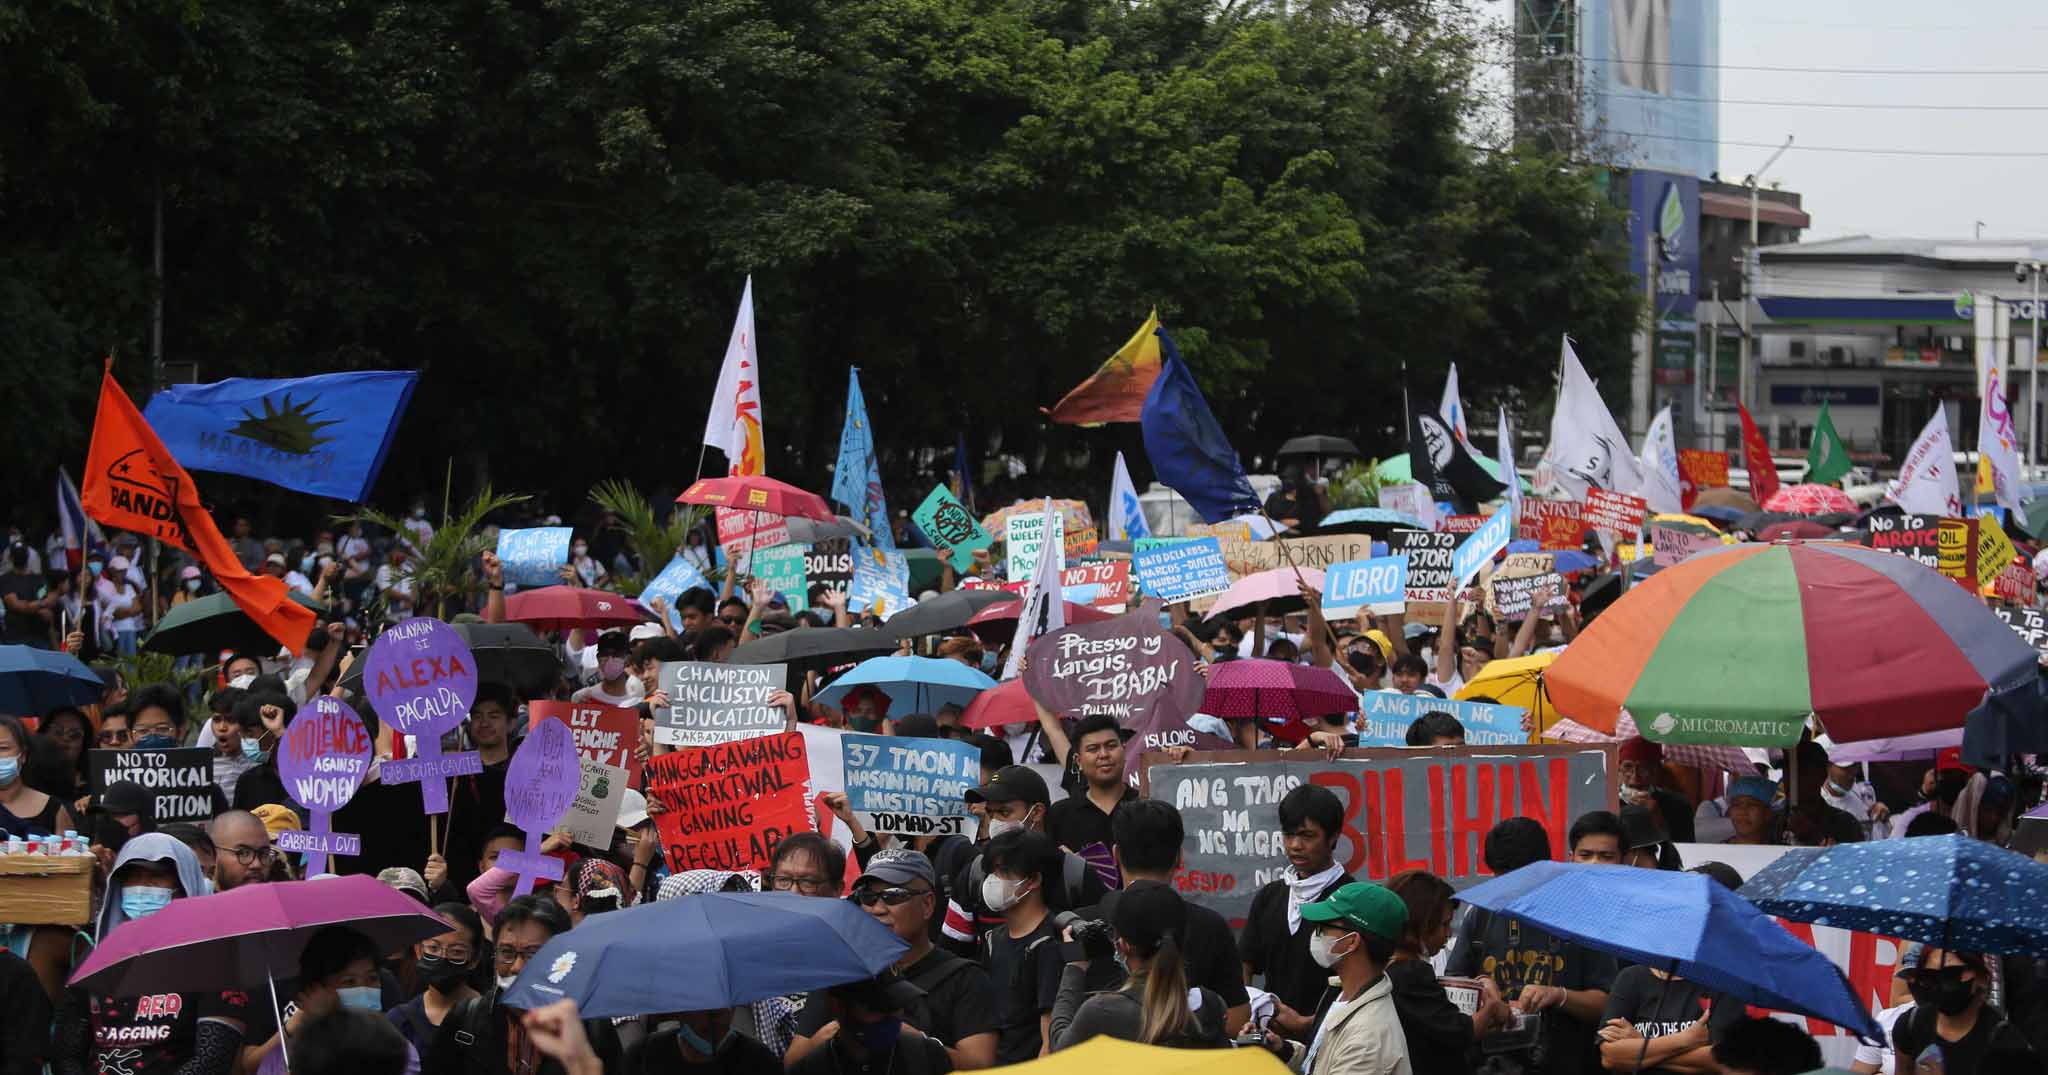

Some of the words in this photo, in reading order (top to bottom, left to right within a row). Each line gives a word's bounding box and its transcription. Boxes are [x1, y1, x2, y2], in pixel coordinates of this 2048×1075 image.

[1011, 515, 1062, 529] STUDET
[1870, 516, 1893, 533] No
[1901, 515, 1924, 530] To
[1405, 532, 1430, 547] NO
[1434, 533, 1456, 547] TO
[1459, 513, 1507, 574] HINDI
[1939, 531, 1959, 545] OIL
[804, 553, 853, 574] BOLIS
[1065, 568, 1088, 585] NO
[1093, 565, 1115, 581] TO
[1331, 564, 1400, 601] LIBRO
[1057, 633, 1138, 659] PRESYO
[376, 655, 466, 696] ALEXA
[677, 665, 770, 685] CHAMPION
[317, 700, 340, 713] END
[675, 683, 777, 705] INCLUSIVE
[395, 688, 465, 730] PACALDA
[571, 708, 602, 727] LET
[1372, 697, 1411, 716] ANG
[1471, 705, 1494, 723] NG
[288, 711, 368, 765] VIOLENCE
[1681, 717, 1790, 737] MICROMATIC
[117, 752, 141, 768] NO
[144, 752, 167, 768] TO
[314, 757, 363, 773] AGAINST
[650, 733, 802, 788] MANGGAGAWANG
[847, 744, 880, 767] 37
[889, 747, 956, 777] TAON
[296, 776, 356, 807] WOMEN
[1176, 778, 1229, 811] ANG
[679, 802, 754, 836] GAWING
[1222, 809, 1250, 833] NA
[1308, 757, 1570, 882] BILIHIN
[1199, 829, 1228, 855] NG
